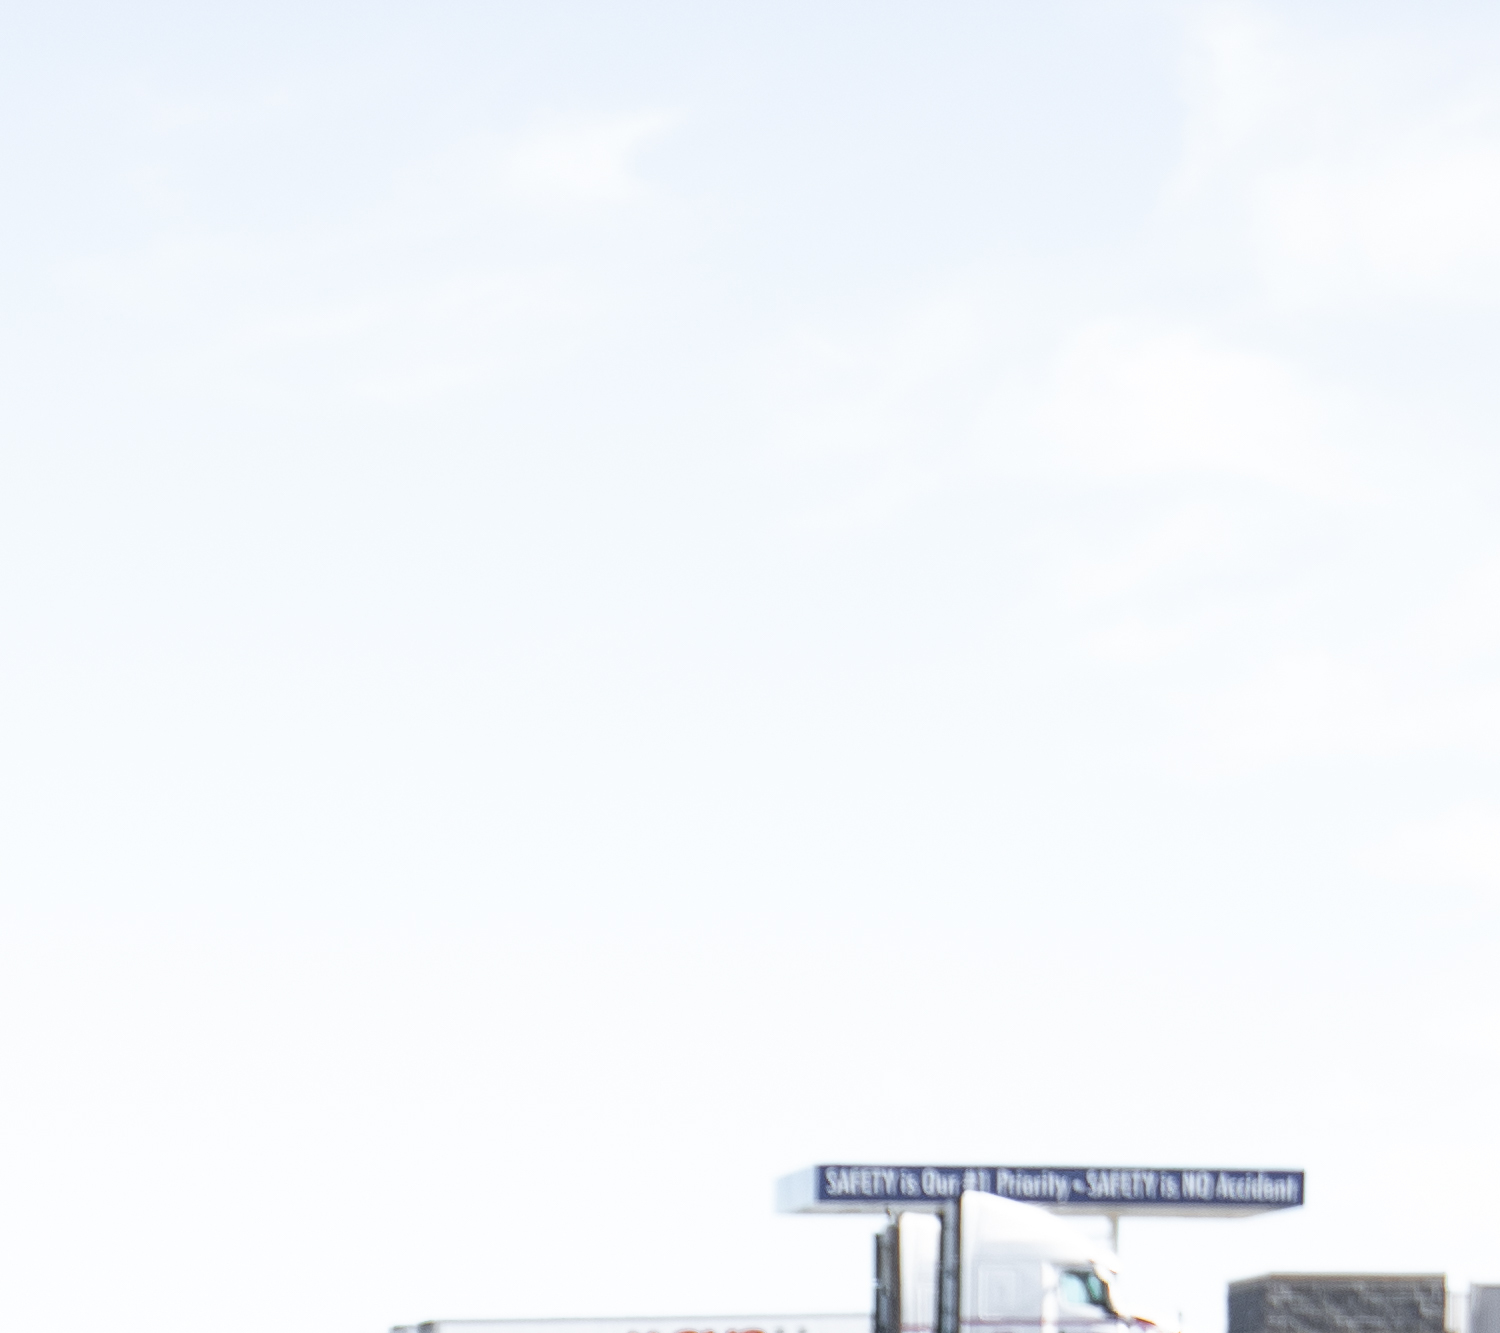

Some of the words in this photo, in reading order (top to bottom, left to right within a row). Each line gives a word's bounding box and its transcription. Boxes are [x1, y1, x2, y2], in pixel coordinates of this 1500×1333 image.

[825, 1167, 895, 1196] SAFETY
[900, 1168, 921, 1196] is
[921, 1167, 958, 1197] Our
[996, 1168, 1070, 1200] Priority
[1086, 1168, 1157, 1199] SAFETY
[1160, 1170, 1180, 1199] is
[1181, 1170, 1214, 1200] NO
[1215, 1170, 1298, 1203] Accident
